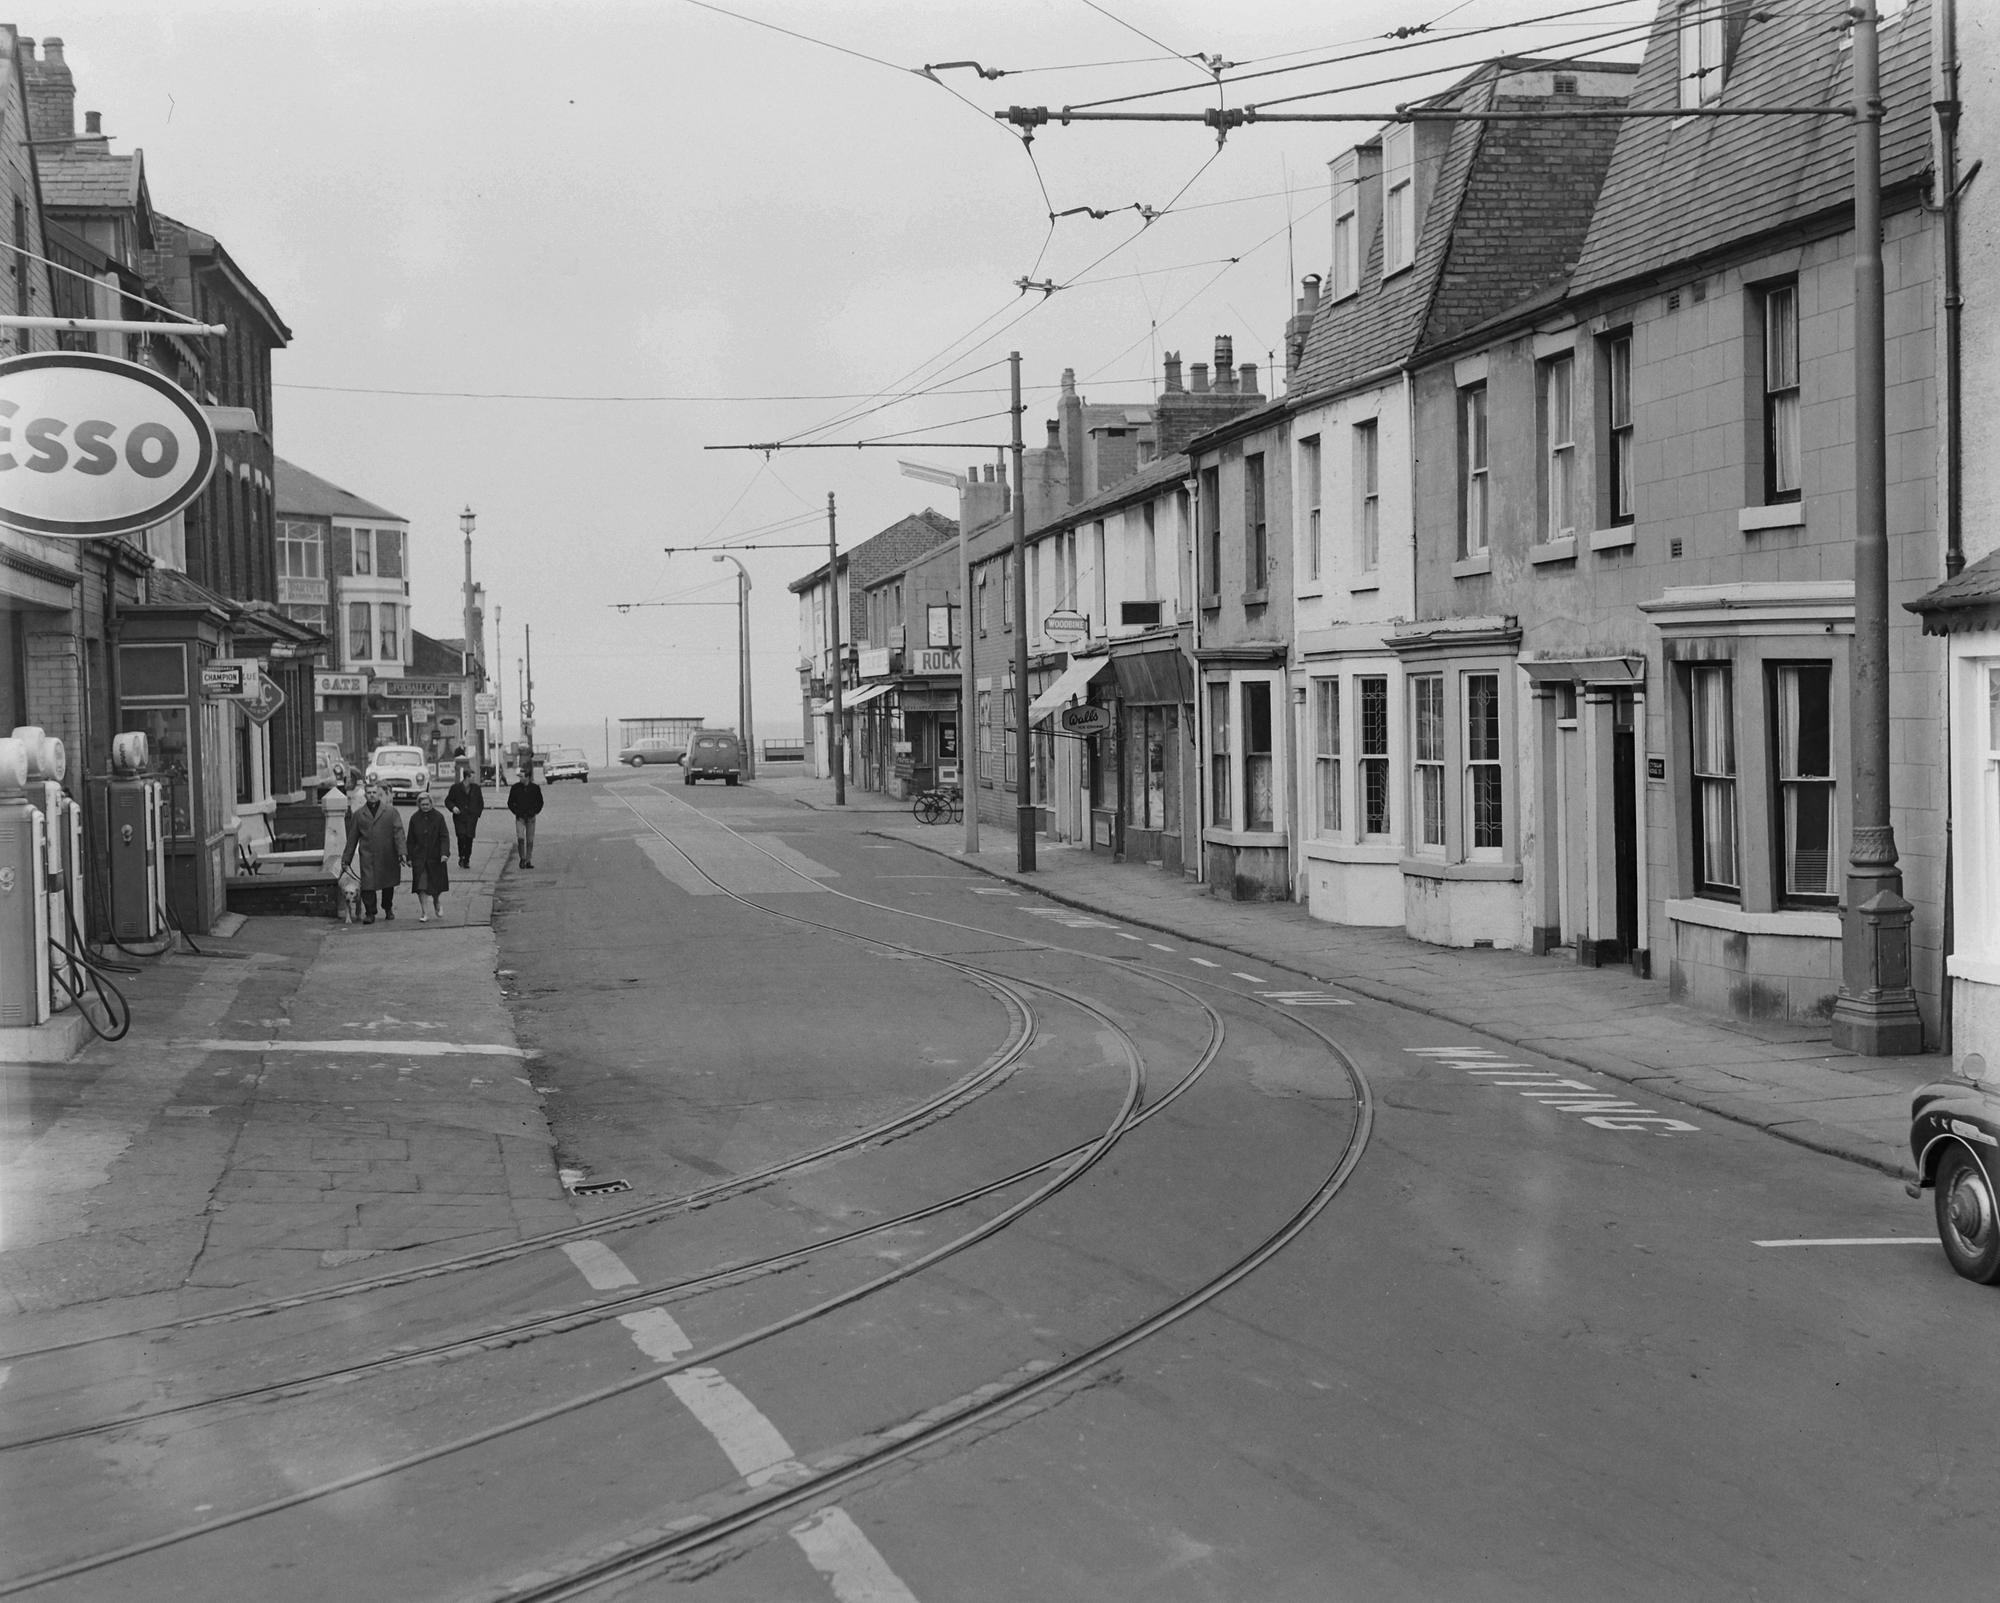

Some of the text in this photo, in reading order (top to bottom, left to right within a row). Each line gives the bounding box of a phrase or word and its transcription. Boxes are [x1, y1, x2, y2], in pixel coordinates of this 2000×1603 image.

[1048, 619, 1084, 629] WOODBINE
[923, 651, 962, 670] ROCK
[204, 673, 238, 682] CHAMPION
[321, 678, 361, 691] GATE
